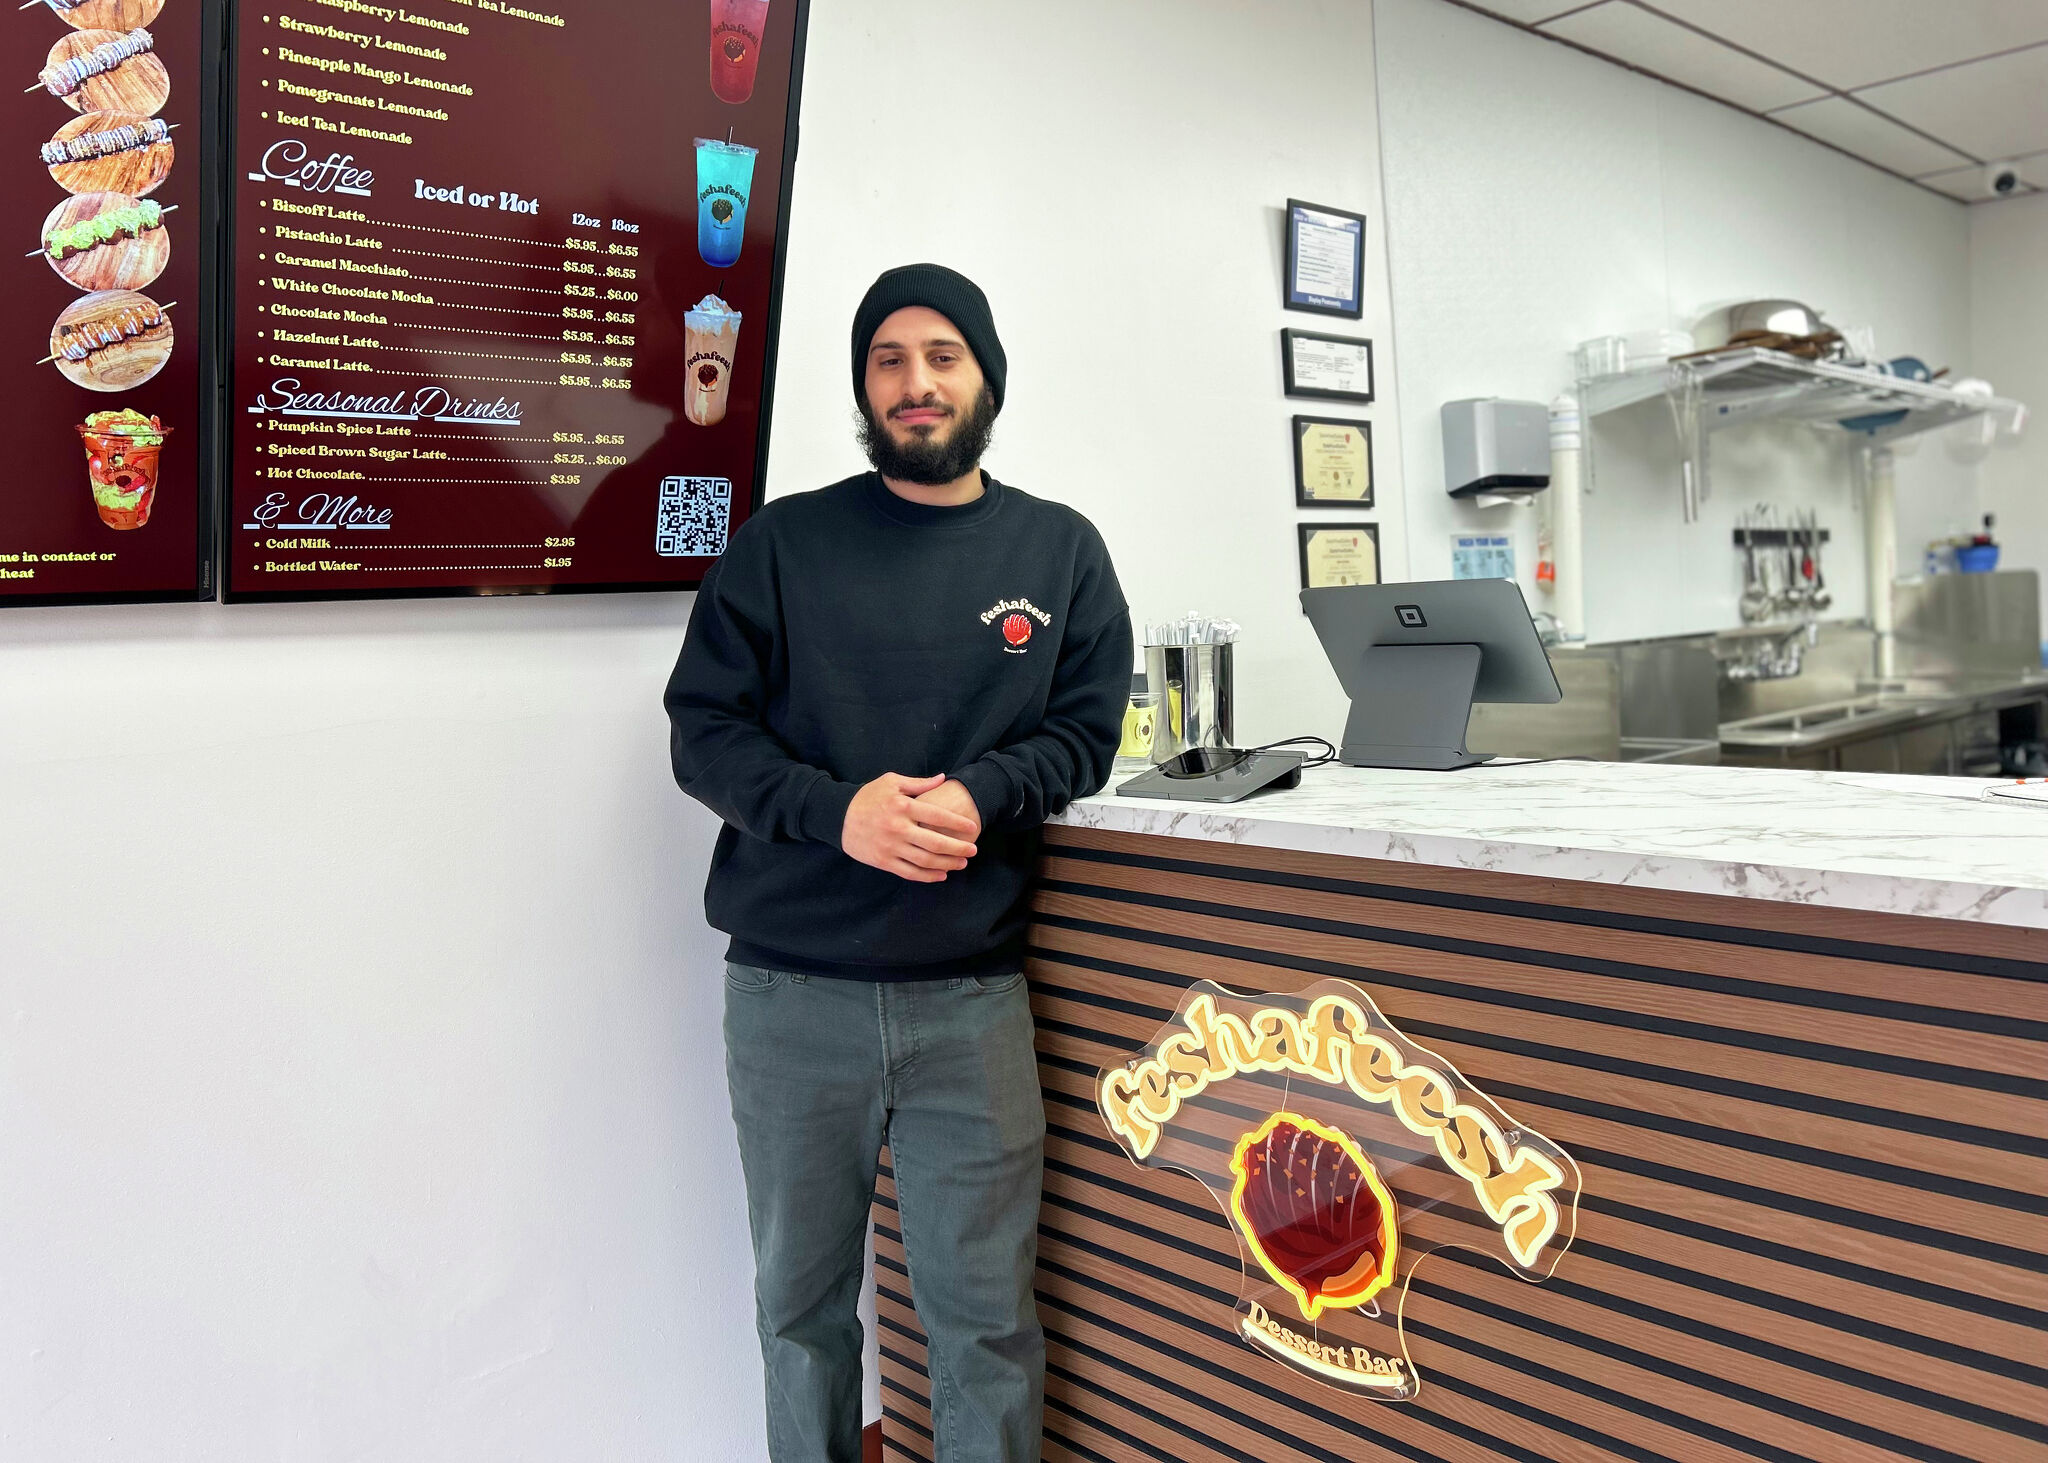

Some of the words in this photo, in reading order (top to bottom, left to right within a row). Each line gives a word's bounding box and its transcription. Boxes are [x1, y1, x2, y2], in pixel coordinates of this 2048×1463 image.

[398, 8, 470, 36] Lemonade
[499, 1, 565, 27] Lemonade
[279, 15, 373, 49] Strawberry
[374, 34, 448, 61] Lemonade
[278, 46, 352, 73] Pineapple
[353, 61, 402, 85] Mango
[403, 71, 474, 96] Lemonade
[277, 78, 376, 108] Pomegranate
[377, 97, 449, 121] Lemonade
[277, 110, 309, 128] Iced
[311, 116, 338, 133] Tea
[339, 121, 413, 145] Lemonade
[260, 139, 375, 193] Coffee
[414, 178, 464, 205] Iced
[468, 192, 496, 208] or
[498, 191, 540, 215] Hot
[272, 198, 328, 217] Biscoff
[327, 205, 367, 222] Latte
[564, 237, 597, 252] $5.95
[608, 242, 639, 257] $6.55
[572, 212, 601, 228] 12oz
[611, 218, 640, 234] 18oz
[275, 225, 343, 245] Pistachio
[344, 234, 383, 250] Latte
[562, 259, 595, 275] $5.95
[605, 265, 637, 280] $6.55
[274, 251, 337, 270] Caramel
[338, 258, 409, 278] Macchiato
[563, 283, 596, 298] $5.25
[606, 288, 639, 302] $6.00
[271, 277, 320, 294] White
[321, 282, 390, 300] Chocolate
[391, 289, 435, 305] Mocha
[561, 306, 594, 320] $5.95
[604, 310, 636, 324] $6.55
[270, 303, 342, 321] Chocolate
[343, 309, 388, 325] Mocha
[562, 329, 594, 343] $5.95
[604, 333, 636, 346] $6.55
[273, 328, 341, 346] Hazelnut
[342, 334, 380, 349] Latte
[560, 351, 592, 365] $5.95
[602, 354, 633, 368] $6.55
[269, 354, 331, 370] Caramel
[558, 373, 591, 387] $5.95
[601, 376, 632, 390] $6.55
[256, 377, 406, 414] Seasonal
[409, 386, 524, 421] Drinks
[268, 419, 335, 437] Pumpkin
[336, 422, 374, 437] Spice
[375, 424, 412, 436] Latte
[552, 431, 584, 444] $5.95
[594, 432, 625, 445] $6.55
[267, 443, 316, 458] Spiced
[318, 445, 367, 458] Brown
[368, 447, 411, 462] Sugar
[412, 448, 447, 460] Latte
[553, 452, 585, 465] $5.25
[595, 453, 627, 466] $6.00
[267, 467, 294, 479] Hot
[549, 473, 581, 485] $3.95
[253, 492, 290, 529] &
[298, 493, 394, 526] More
[22, 551, 39, 563] in
[41, 551, 98, 563] contact
[99, 552, 117, 562] or
[265, 538, 298, 549] Cold
[299, 538, 331, 549] Milk
[544, 536, 576, 549] $2.95
[265, 561, 316, 572] Bottled
[318, 559, 362, 572] Water
[543, 557, 572, 568] $1.95
[980, 598, 1052, 627] feshafeesh
[1102, 994, 1565, 1267] feshafeesh
[1247, 1299, 1348, 1369] Dessert
[1351, 1346, 1405, 1376] Bar
